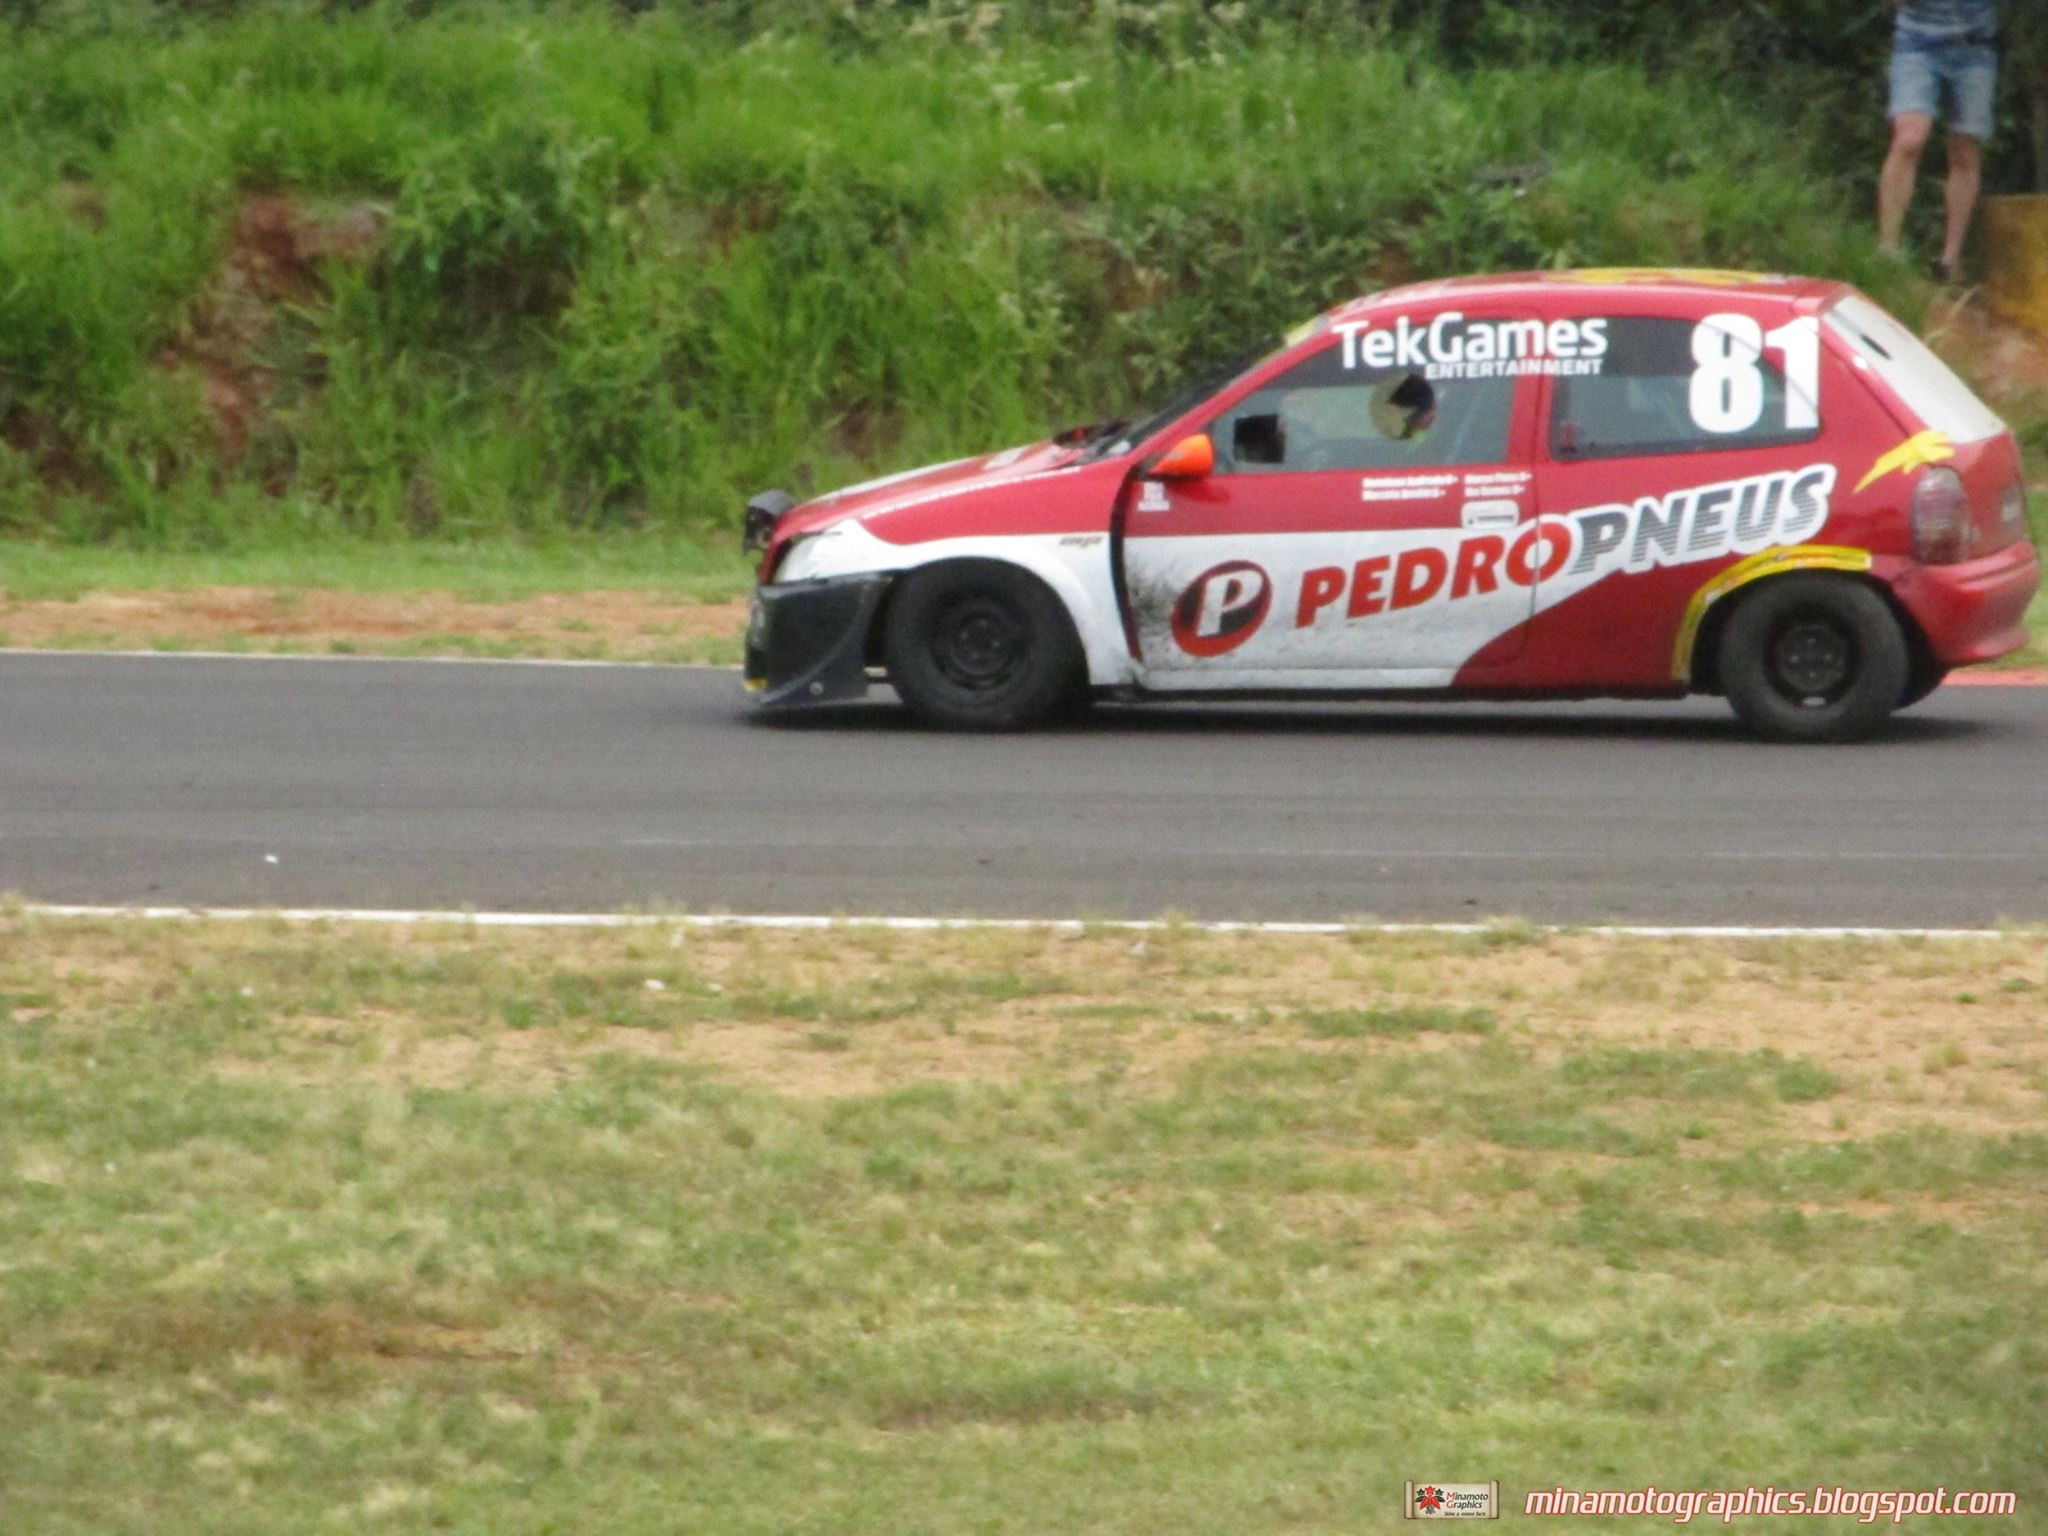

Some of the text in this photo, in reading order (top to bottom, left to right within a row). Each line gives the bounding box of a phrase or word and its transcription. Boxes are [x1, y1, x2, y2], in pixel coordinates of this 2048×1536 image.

[1332, 311, 1609, 369] TekGames
[1424, 358, 1604, 380] ENTERTAINMENT
[1689, 313, 1820, 433] 81
